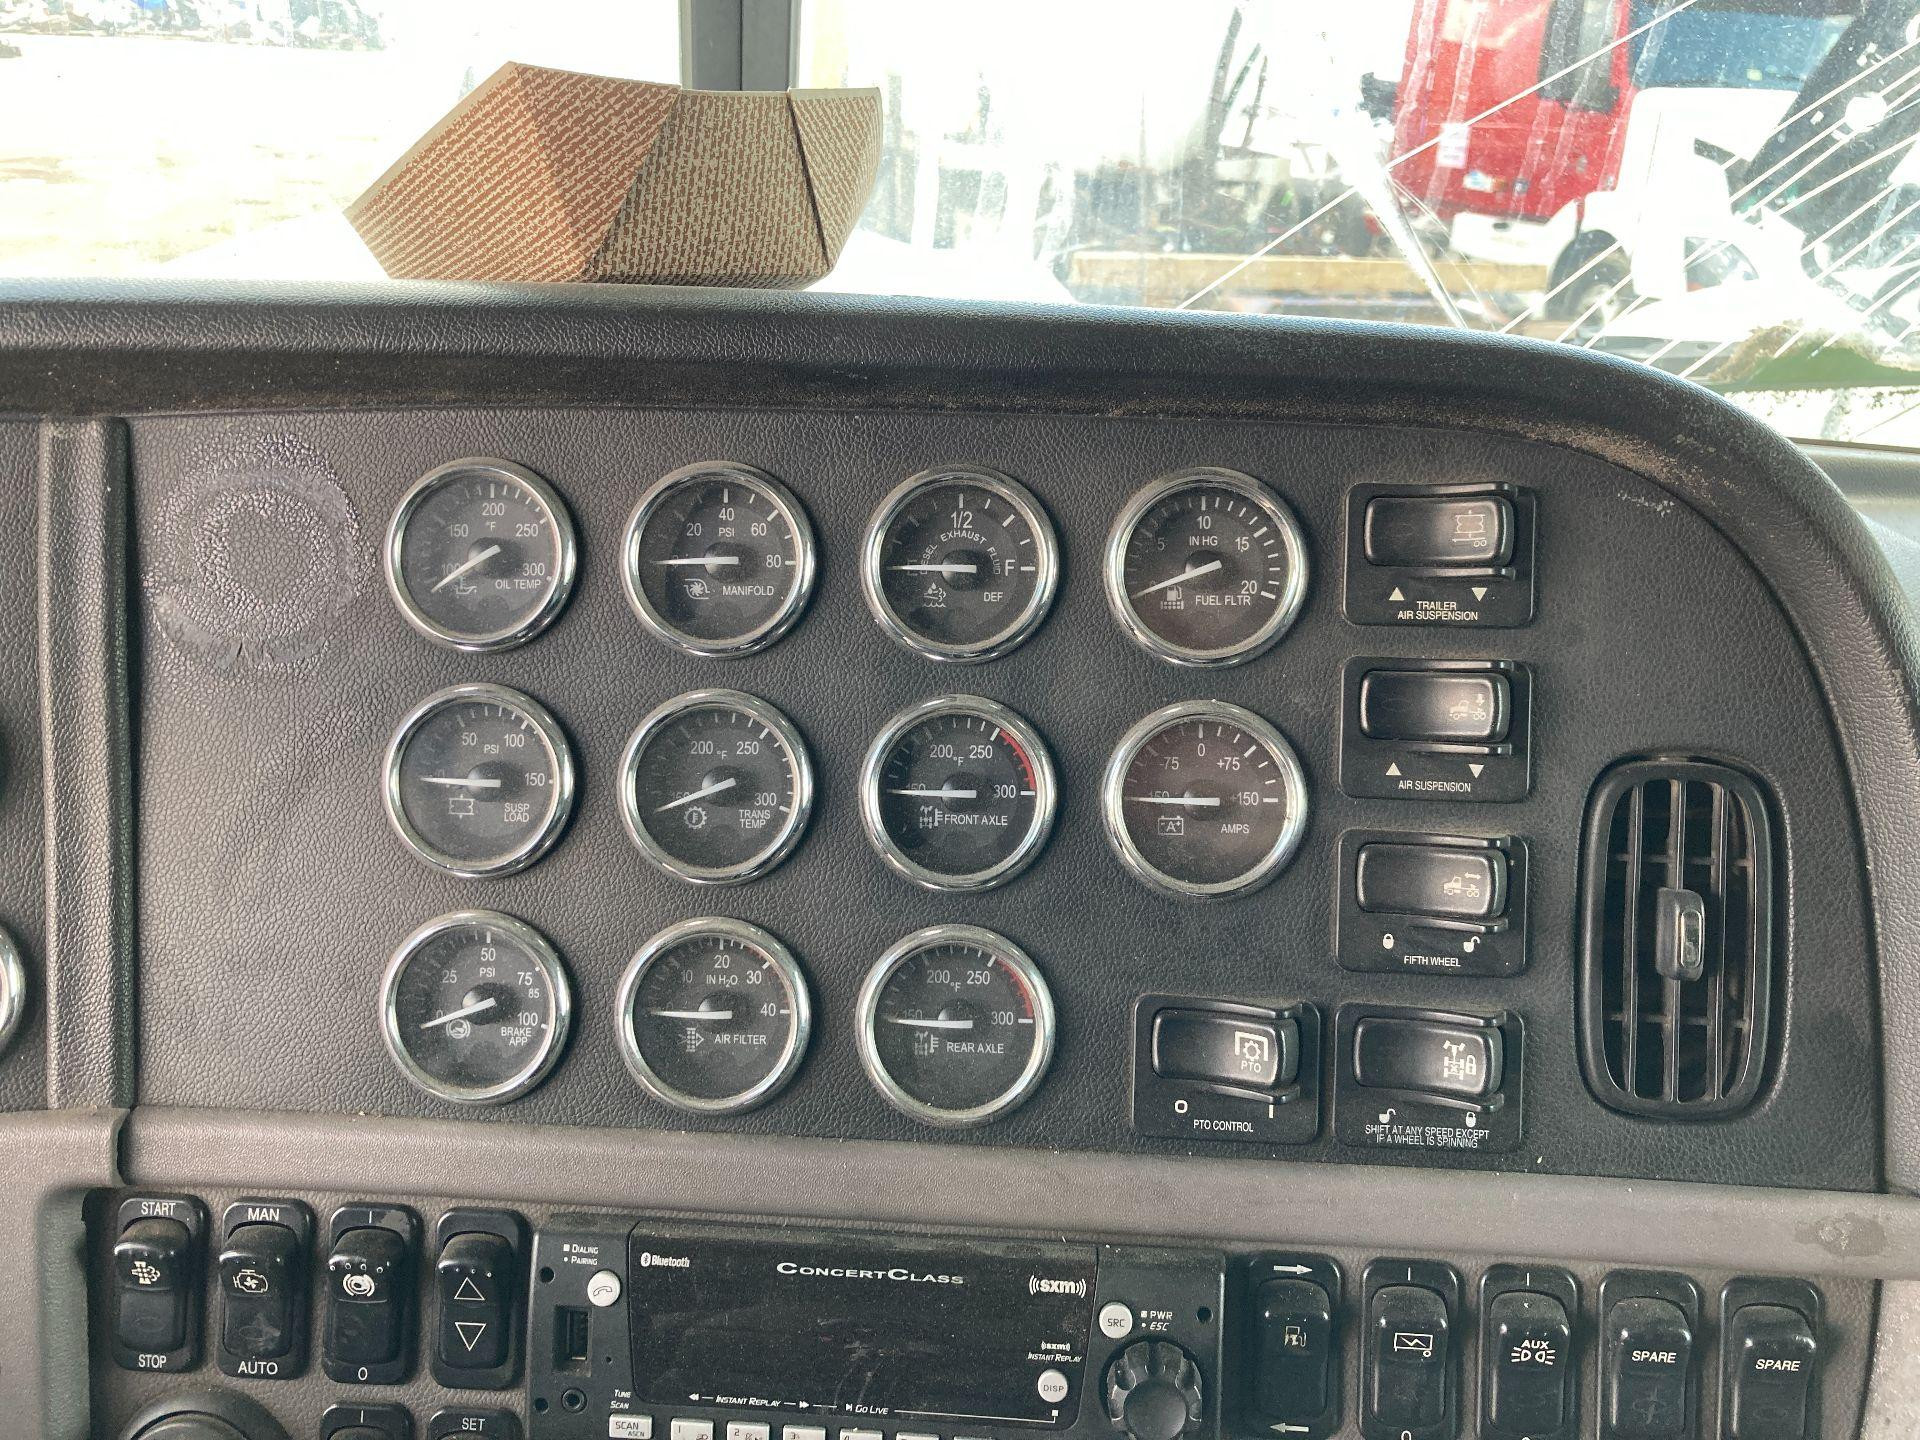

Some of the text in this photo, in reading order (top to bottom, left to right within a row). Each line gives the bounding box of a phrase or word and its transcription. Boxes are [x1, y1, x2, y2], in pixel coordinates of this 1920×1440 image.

[482, 502, 505, 516] 200
[718, 507, 735, 521] 40
[950, 511, 973, 529] 1/2
[1196, 515, 1211, 530] 10
[450, 523, 469, 537] 150
[515, 523, 539, 537] 250
[686, 522, 702, 536] 20
[718, 528, 735, 538] PSI
[751, 522, 767, 536] 60
[1157, 537, 1166, 551] 5
[1189, 535, 1218, 547] IN HG
[1235, 536, 1249, 550] 15
[940, 530, 987, 545] EXHAUST
[986, 545, 1001, 576] FLUID
[765, 554, 781, 568] 80
[1004, 559, 1016, 577] F
[522, 562, 545, 576] 300
[495, 579, 541, 590] OIL TEMP
[722, 585, 774, 596] MANIFOLD
[1241, 580, 1257, 594] 20
[983, 592, 1004, 602] DEF
[1195, 595, 1251, 606] FUEL FLTR
[1416, 601, 1457, 611] TRAILER
[1397, 611, 1479, 621] AIR SUSPENSION
[461, 732, 477, 746] 50
[503, 733, 525, 748] 100
[483, 744, 500, 754] PSI
[690, 740, 714, 755] 200
[736, 741, 759, 755] 250
[930, 744, 953, 759] 200
[969, 745, 993, 759] 250
[1197, 743, 1206, 757] 0
[1216, 757, 1240, 771] +75
[524, 772, 545, 787] 150
[1398, 780, 1471, 792] AIR SUSPENSION
[994, 784, 1016, 799] 300
[754, 792, 777, 806] 300
[504, 803, 530, 813] SUSP
[739, 809, 771, 820] TRANS
[503, 813, 530, 823] LOAD
[741, 819, 766, 829] TEMP
[944, 814, 1008, 826] FRONT AXLE
[1220, 823, 1250, 834] AMPS
[480, 948, 496, 962] 50
[713, 955, 730, 969] 20
[1403, 955, 1462, 967] FIFTH WHEEL
[442, 970, 458, 984] 25
[479, 967, 496, 978] PSI
[517, 971, 533, 986] 75
[682, 969, 694, 983] 10
[706, 974, 716, 985] IN
[746, 970, 762, 984] 30
[927, 970, 950, 984] 200
[966, 971, 990, 985] 250
[528, 988, 540, 999] 85
[760, 1002, 776, 1016] 40
[517, 1012, 539, 1026] 100
[990, 1011, 1014, 1026] 300
[501, 1026, 532, 1037] BRAKE
[509, 1037, 528, 1047] APP
[713, 1034, 767, 1045] AIR FILTER
[946, 1042, 1005, 1054] REAR AXLE
[1241, 1060, 1261, 1073] PTO
[1193, 1120, 1254, 1132] PTO CONTROL
[1365, 1124, 1490, 1140] SHIFT AT ANY SPEED EXCEPT
[1376, 1134, 1478, 1149] IF A WHEEL IS SPINNING
[141, 1201, 177, 1216] START
[247, 1208, 280, 1221] MAN
[651, 1254, 691, 1269] Bluetooth
[1107, 1317, 1126, 1328] SRC
[1150, 1310, 1174, 1321] PWR
[1149, 1322, 1170, 1332] ESC
[1520, 1340, 1550, 1350] AUX
[138, 1353, 167, 1369] STOP
[1027, 1352, 1083, 1363] INSTANT REPLAY
[1631, 1350, 1677, 1364] SPARE
[237, 1360, 279, 1375] AUTO
[1755, 1358, 1801, 1372] SPARE
[1043, 1384, 1065, 1393] DISP
[715, 1395, 782, 1407] INSTANT REPLAY
[461, 1417, 486, 1432] SET
[615, 1421, 639, 1431] SCAN
